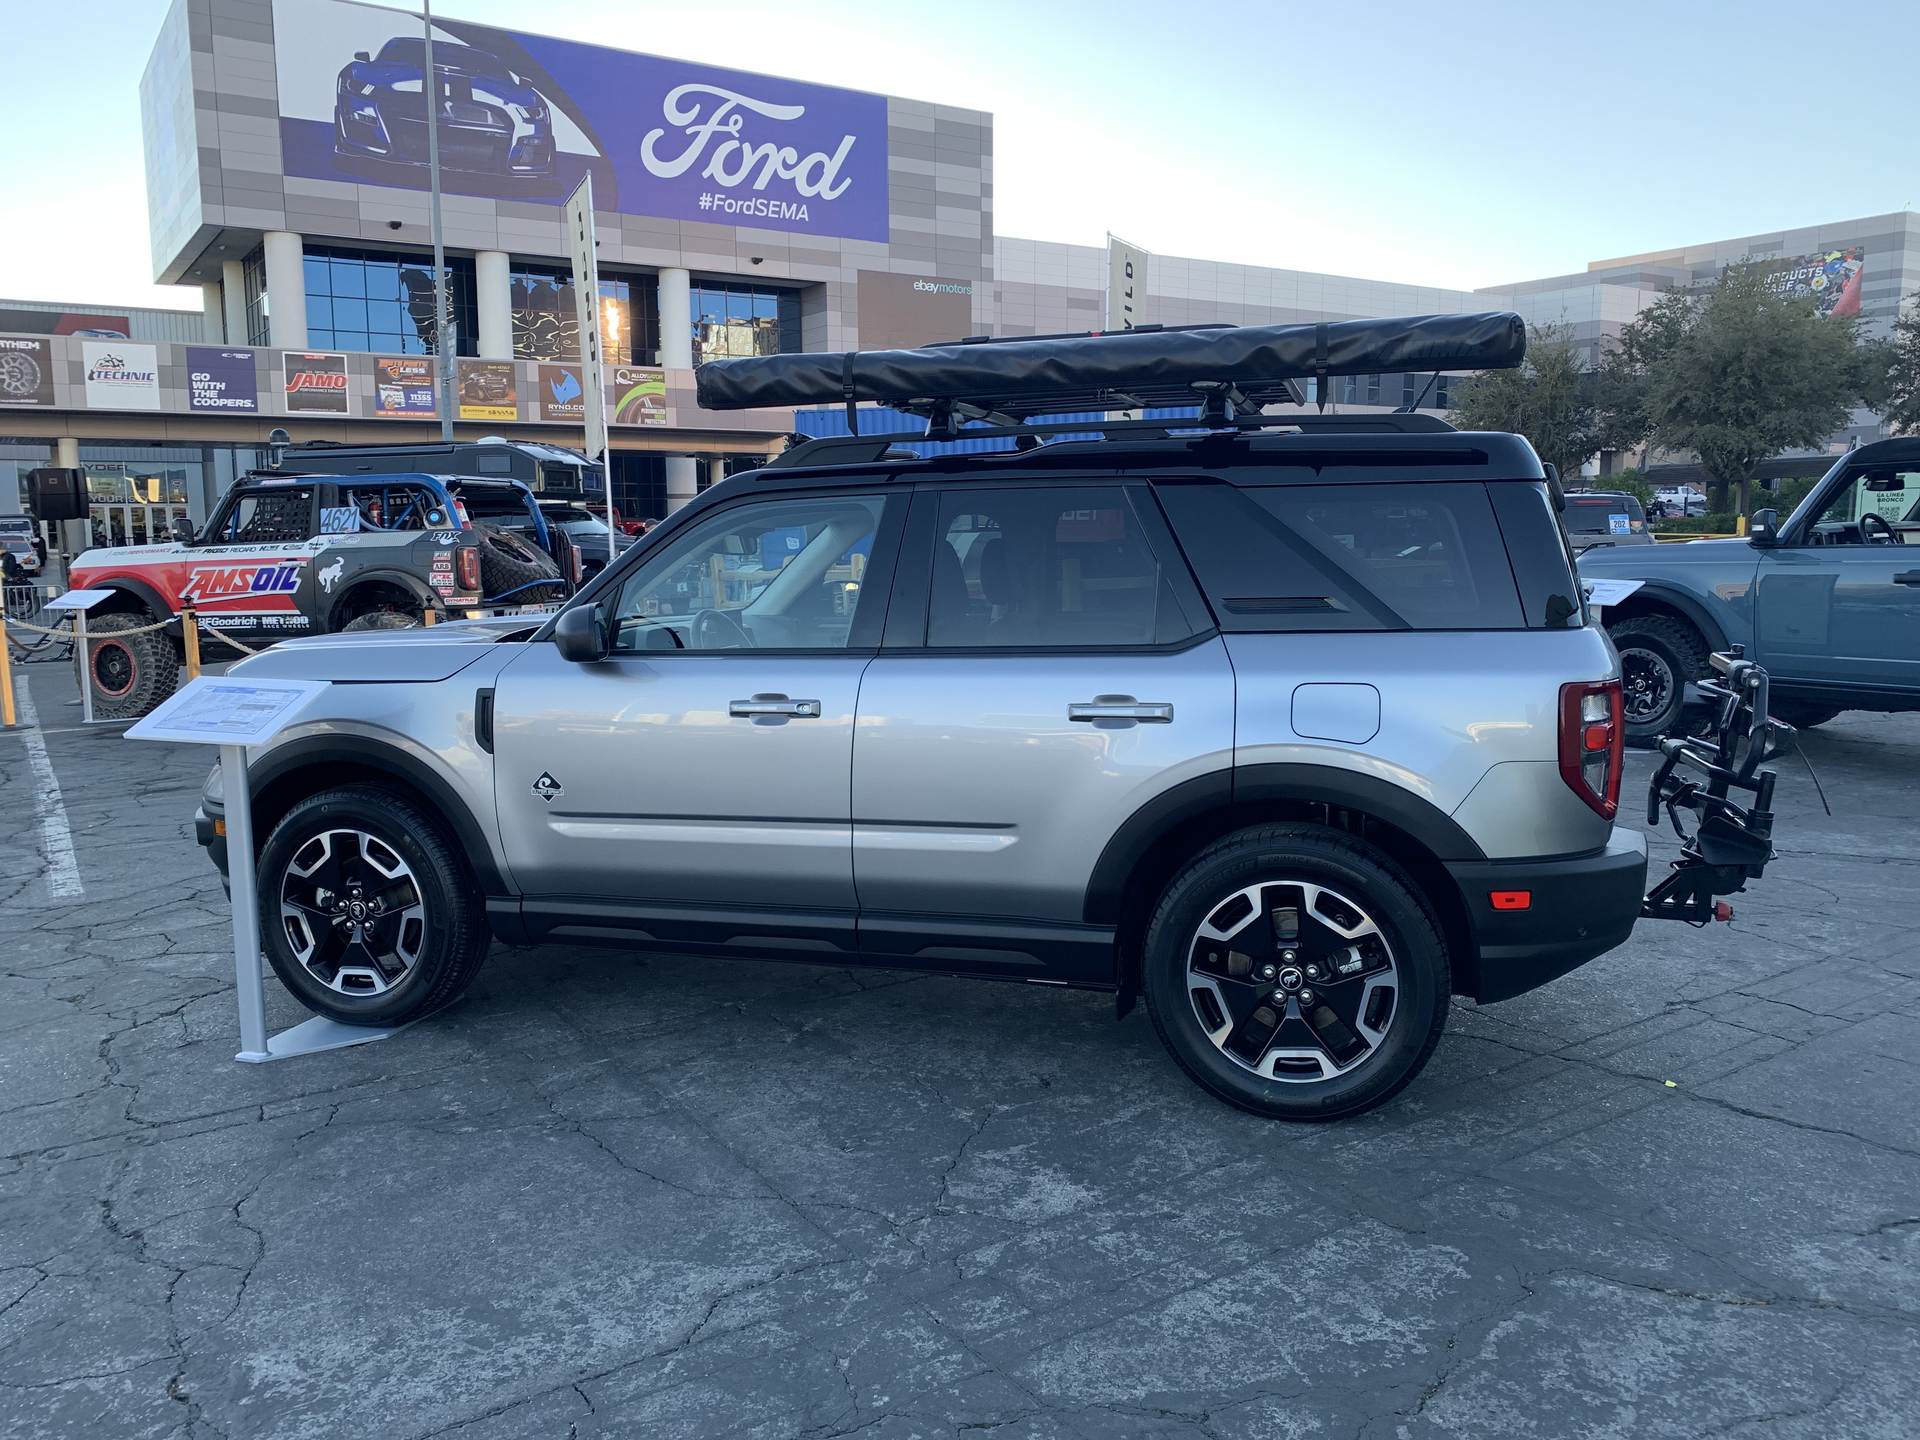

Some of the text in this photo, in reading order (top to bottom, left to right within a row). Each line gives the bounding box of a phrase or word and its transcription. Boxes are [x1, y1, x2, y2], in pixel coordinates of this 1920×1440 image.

[641, 84, 856, 200] Ford
[699, 192, 809, 222] #FordSEMA
[913, 280, 972, 295] ebay motors
[0, 340, 40, 350] AYHEM
[96, 371, 156, 381] TECHNIC
[191, 373, 210, 381] GO
[192, 381, 226, 390] WITH
[285, 373, 348, 393] JAMO
[193, 389, 219, 398] THE
[193, 398, 255, 408] COOPERS.
[321, 508, 358, 532] 4621
[179, 565, 302, 603] AMSOIL
[198, 617, 256, 626] BFGoodrich
